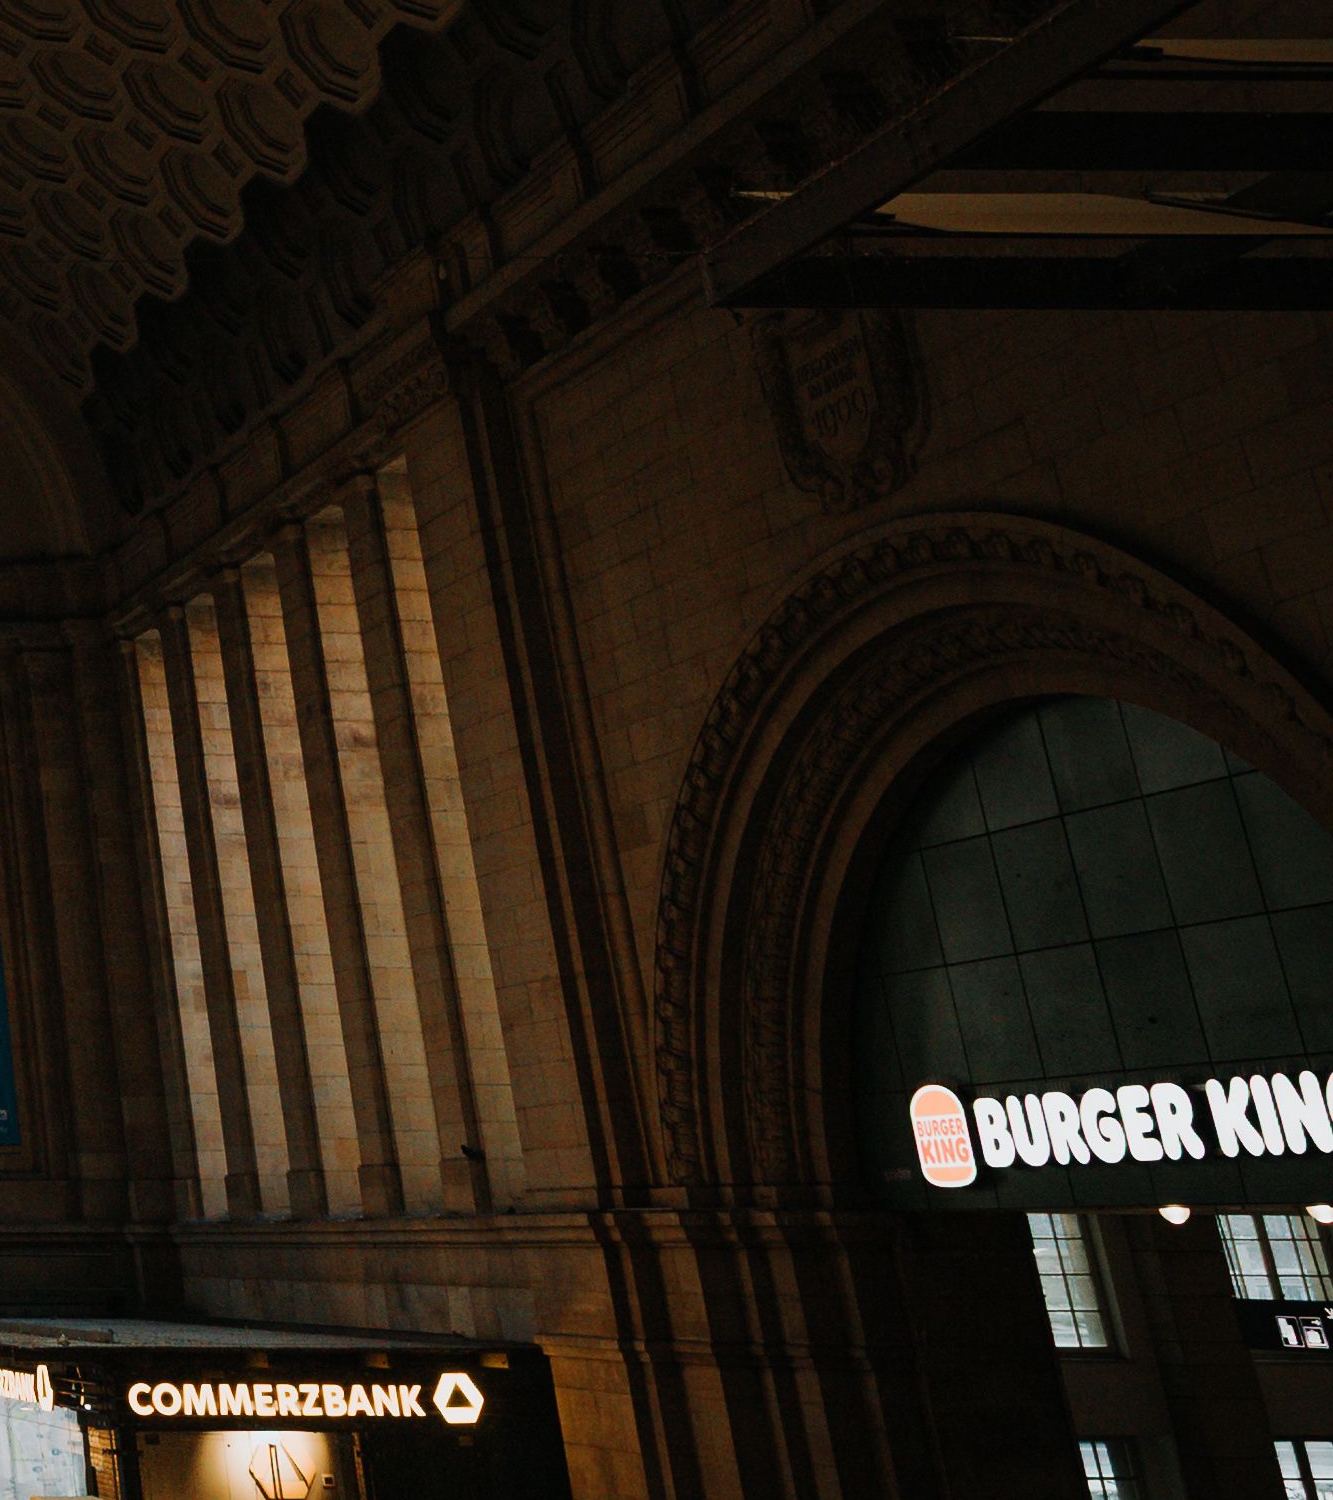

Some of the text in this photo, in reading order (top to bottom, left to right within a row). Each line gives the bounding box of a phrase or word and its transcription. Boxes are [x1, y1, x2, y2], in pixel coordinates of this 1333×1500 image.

[811, 386, 869, 438] 1909
[916, 1118, 965, 1137] BURGER
[973, 1070, 1333, 1168] BURGER KIN
[920, 1137, 970, 1164] KING
[128, 1382, 426, 1418] COMMERZBANK
